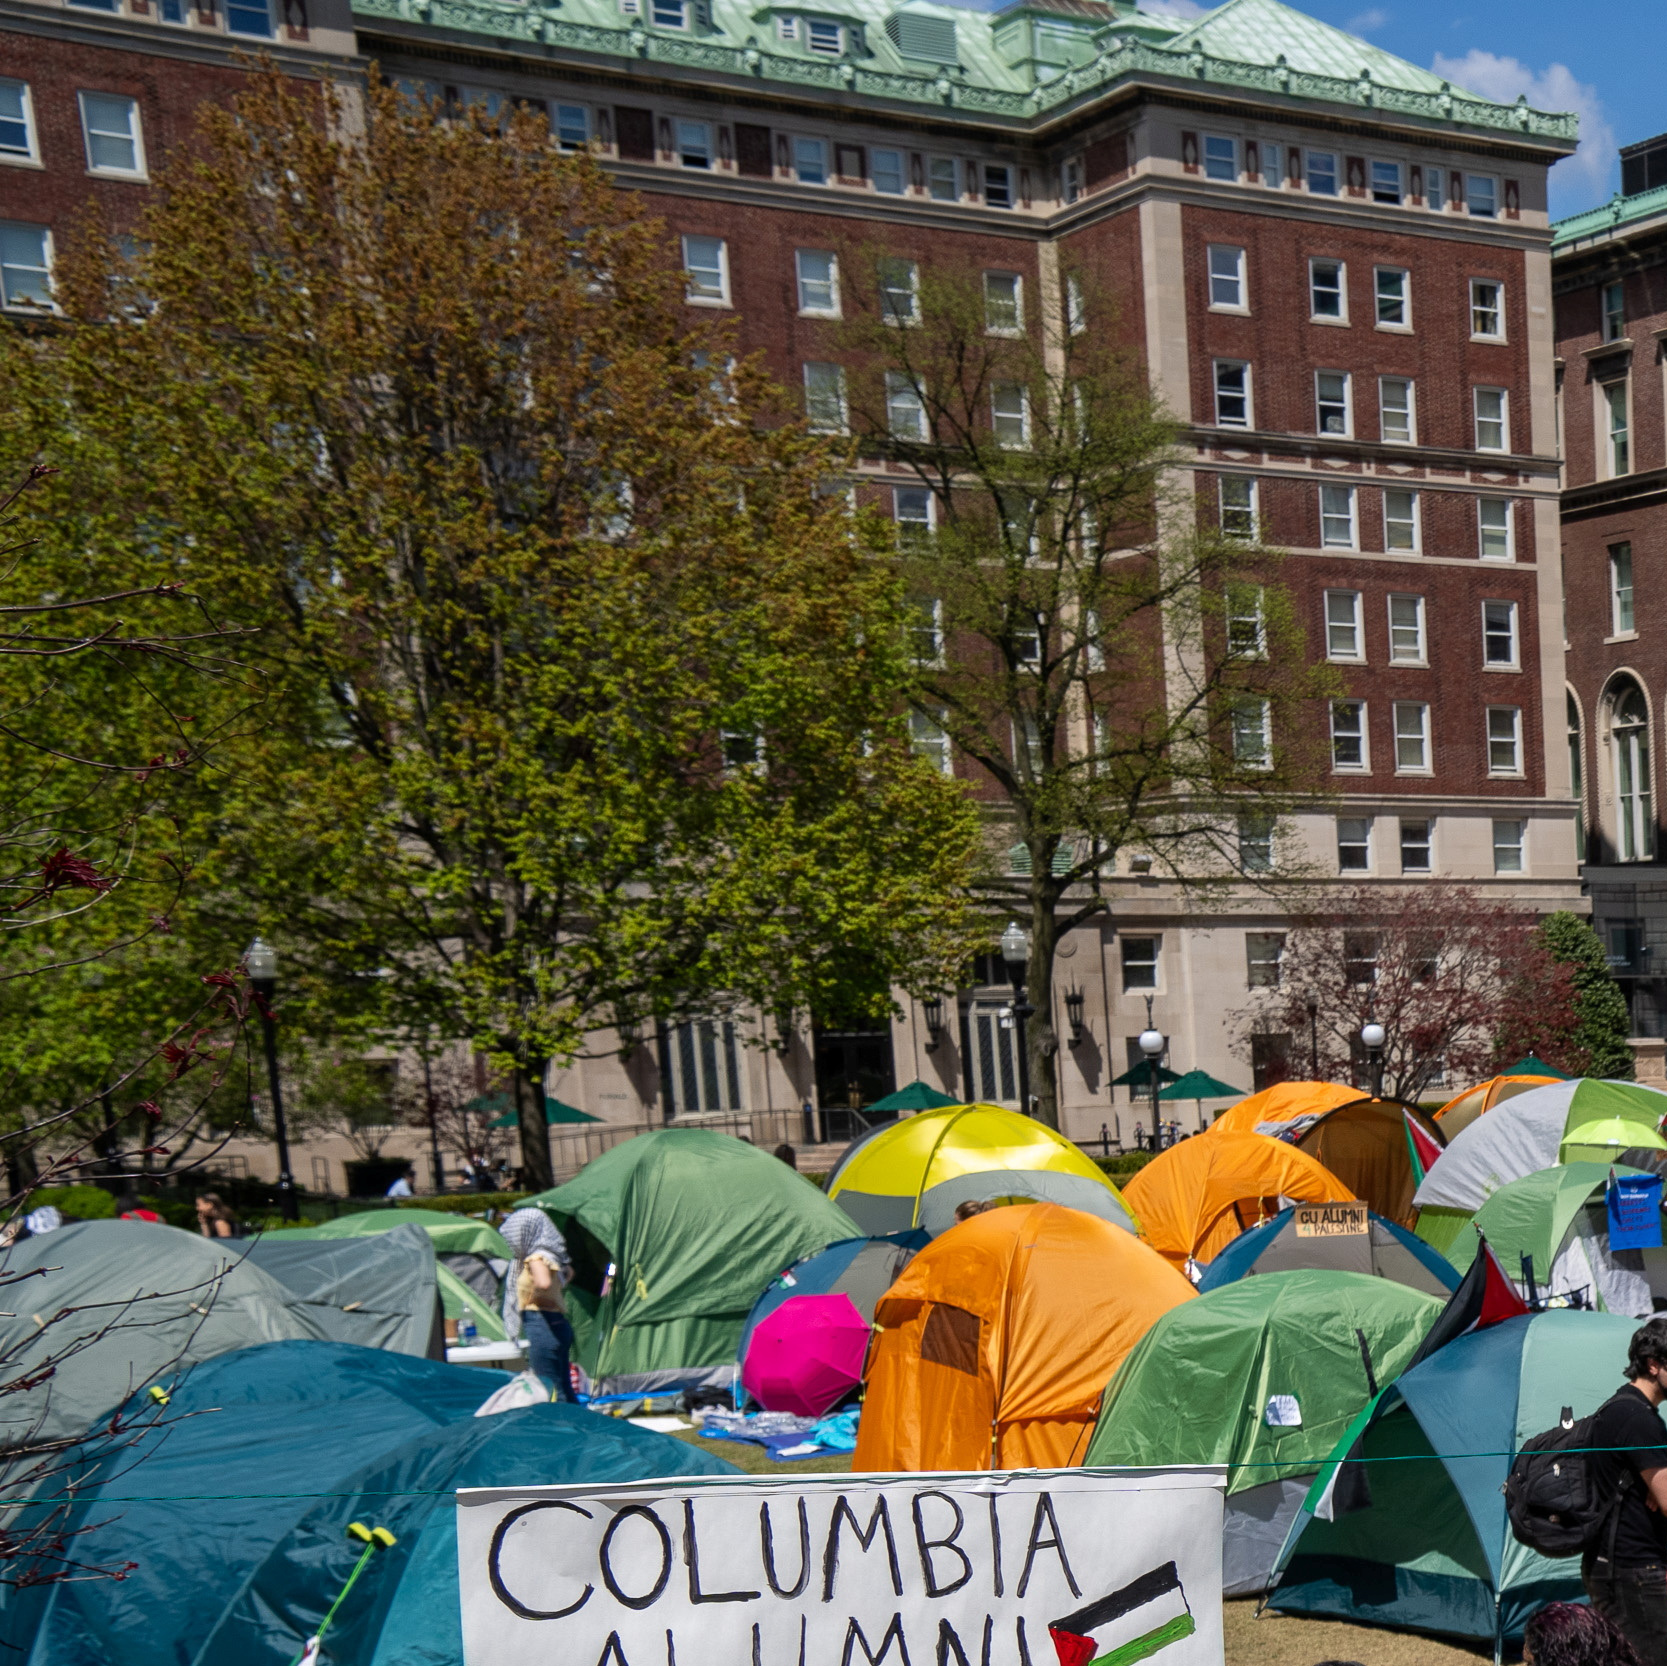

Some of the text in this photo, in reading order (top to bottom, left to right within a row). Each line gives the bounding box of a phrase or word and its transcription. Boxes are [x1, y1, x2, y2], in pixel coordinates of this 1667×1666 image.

[1300, 1208, 1364, 1224] CU ALUMNI
[1314, 1223, 1364, 1235] PALESTINE
[488, 1491, 1082, 1620] COLUMBIA
